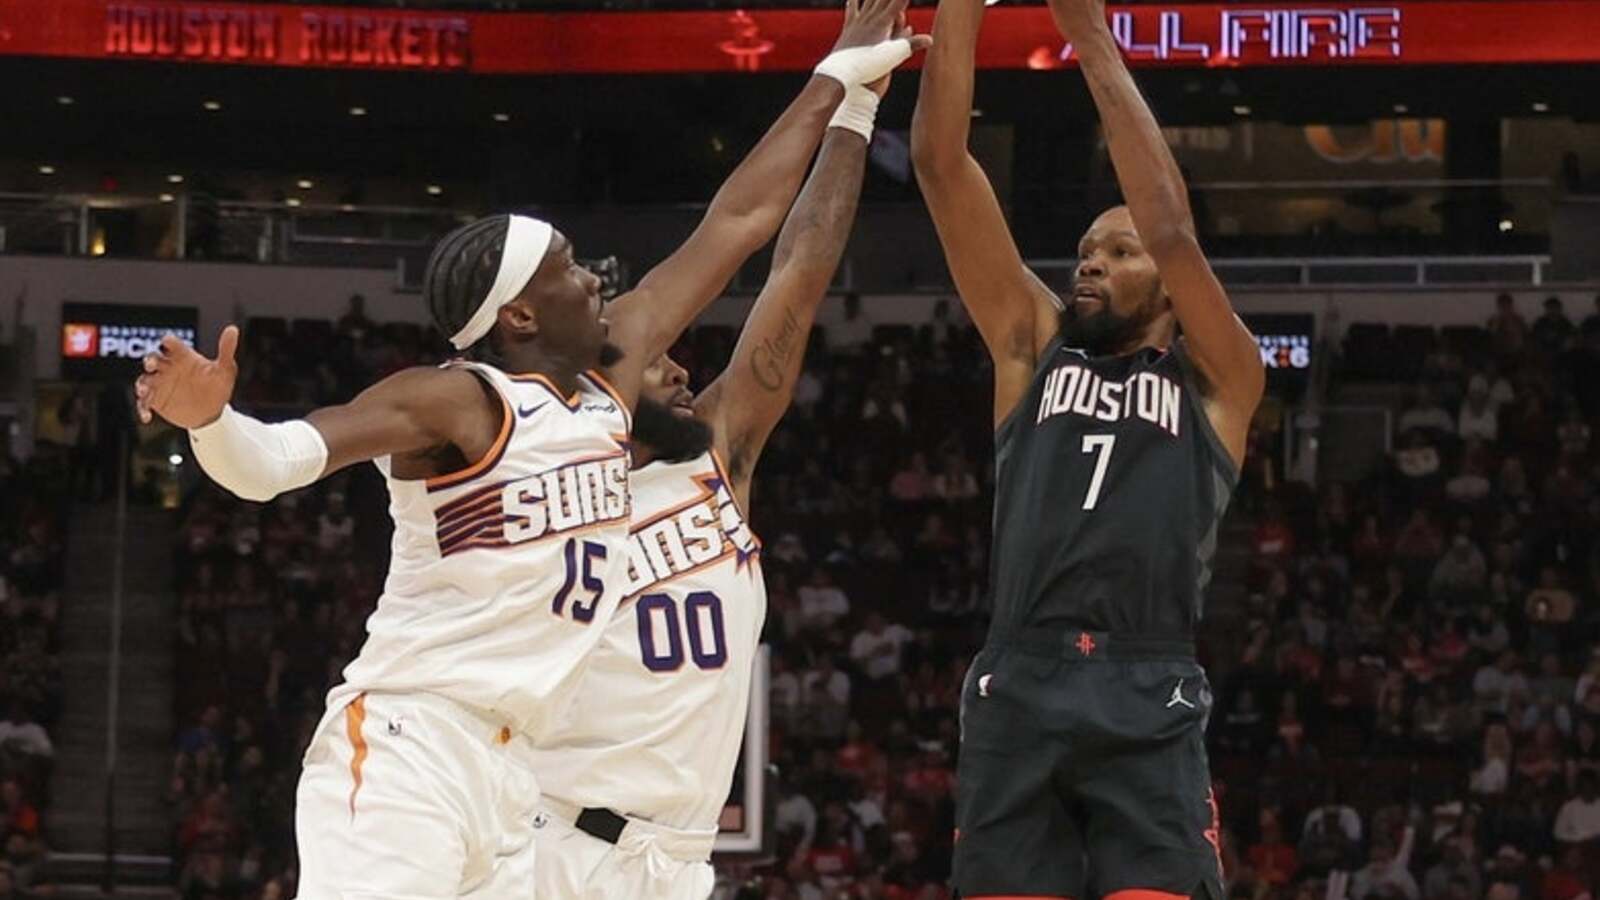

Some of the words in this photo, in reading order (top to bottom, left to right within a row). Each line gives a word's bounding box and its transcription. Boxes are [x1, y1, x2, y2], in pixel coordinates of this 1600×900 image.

[105, 4, 276, 59] HOUSTON
[300, 11, 470, 66] ROCKETS
[1059, 10, 1209, 60] LL
[1220, 8, 1400, 58] FIRE
[1036, 364, 1181, 438] HOUSTON
[1081, 434, 1116, 510] 7
[551, 537, 608, 625] 15
[635, 591, 728, 673] 00
